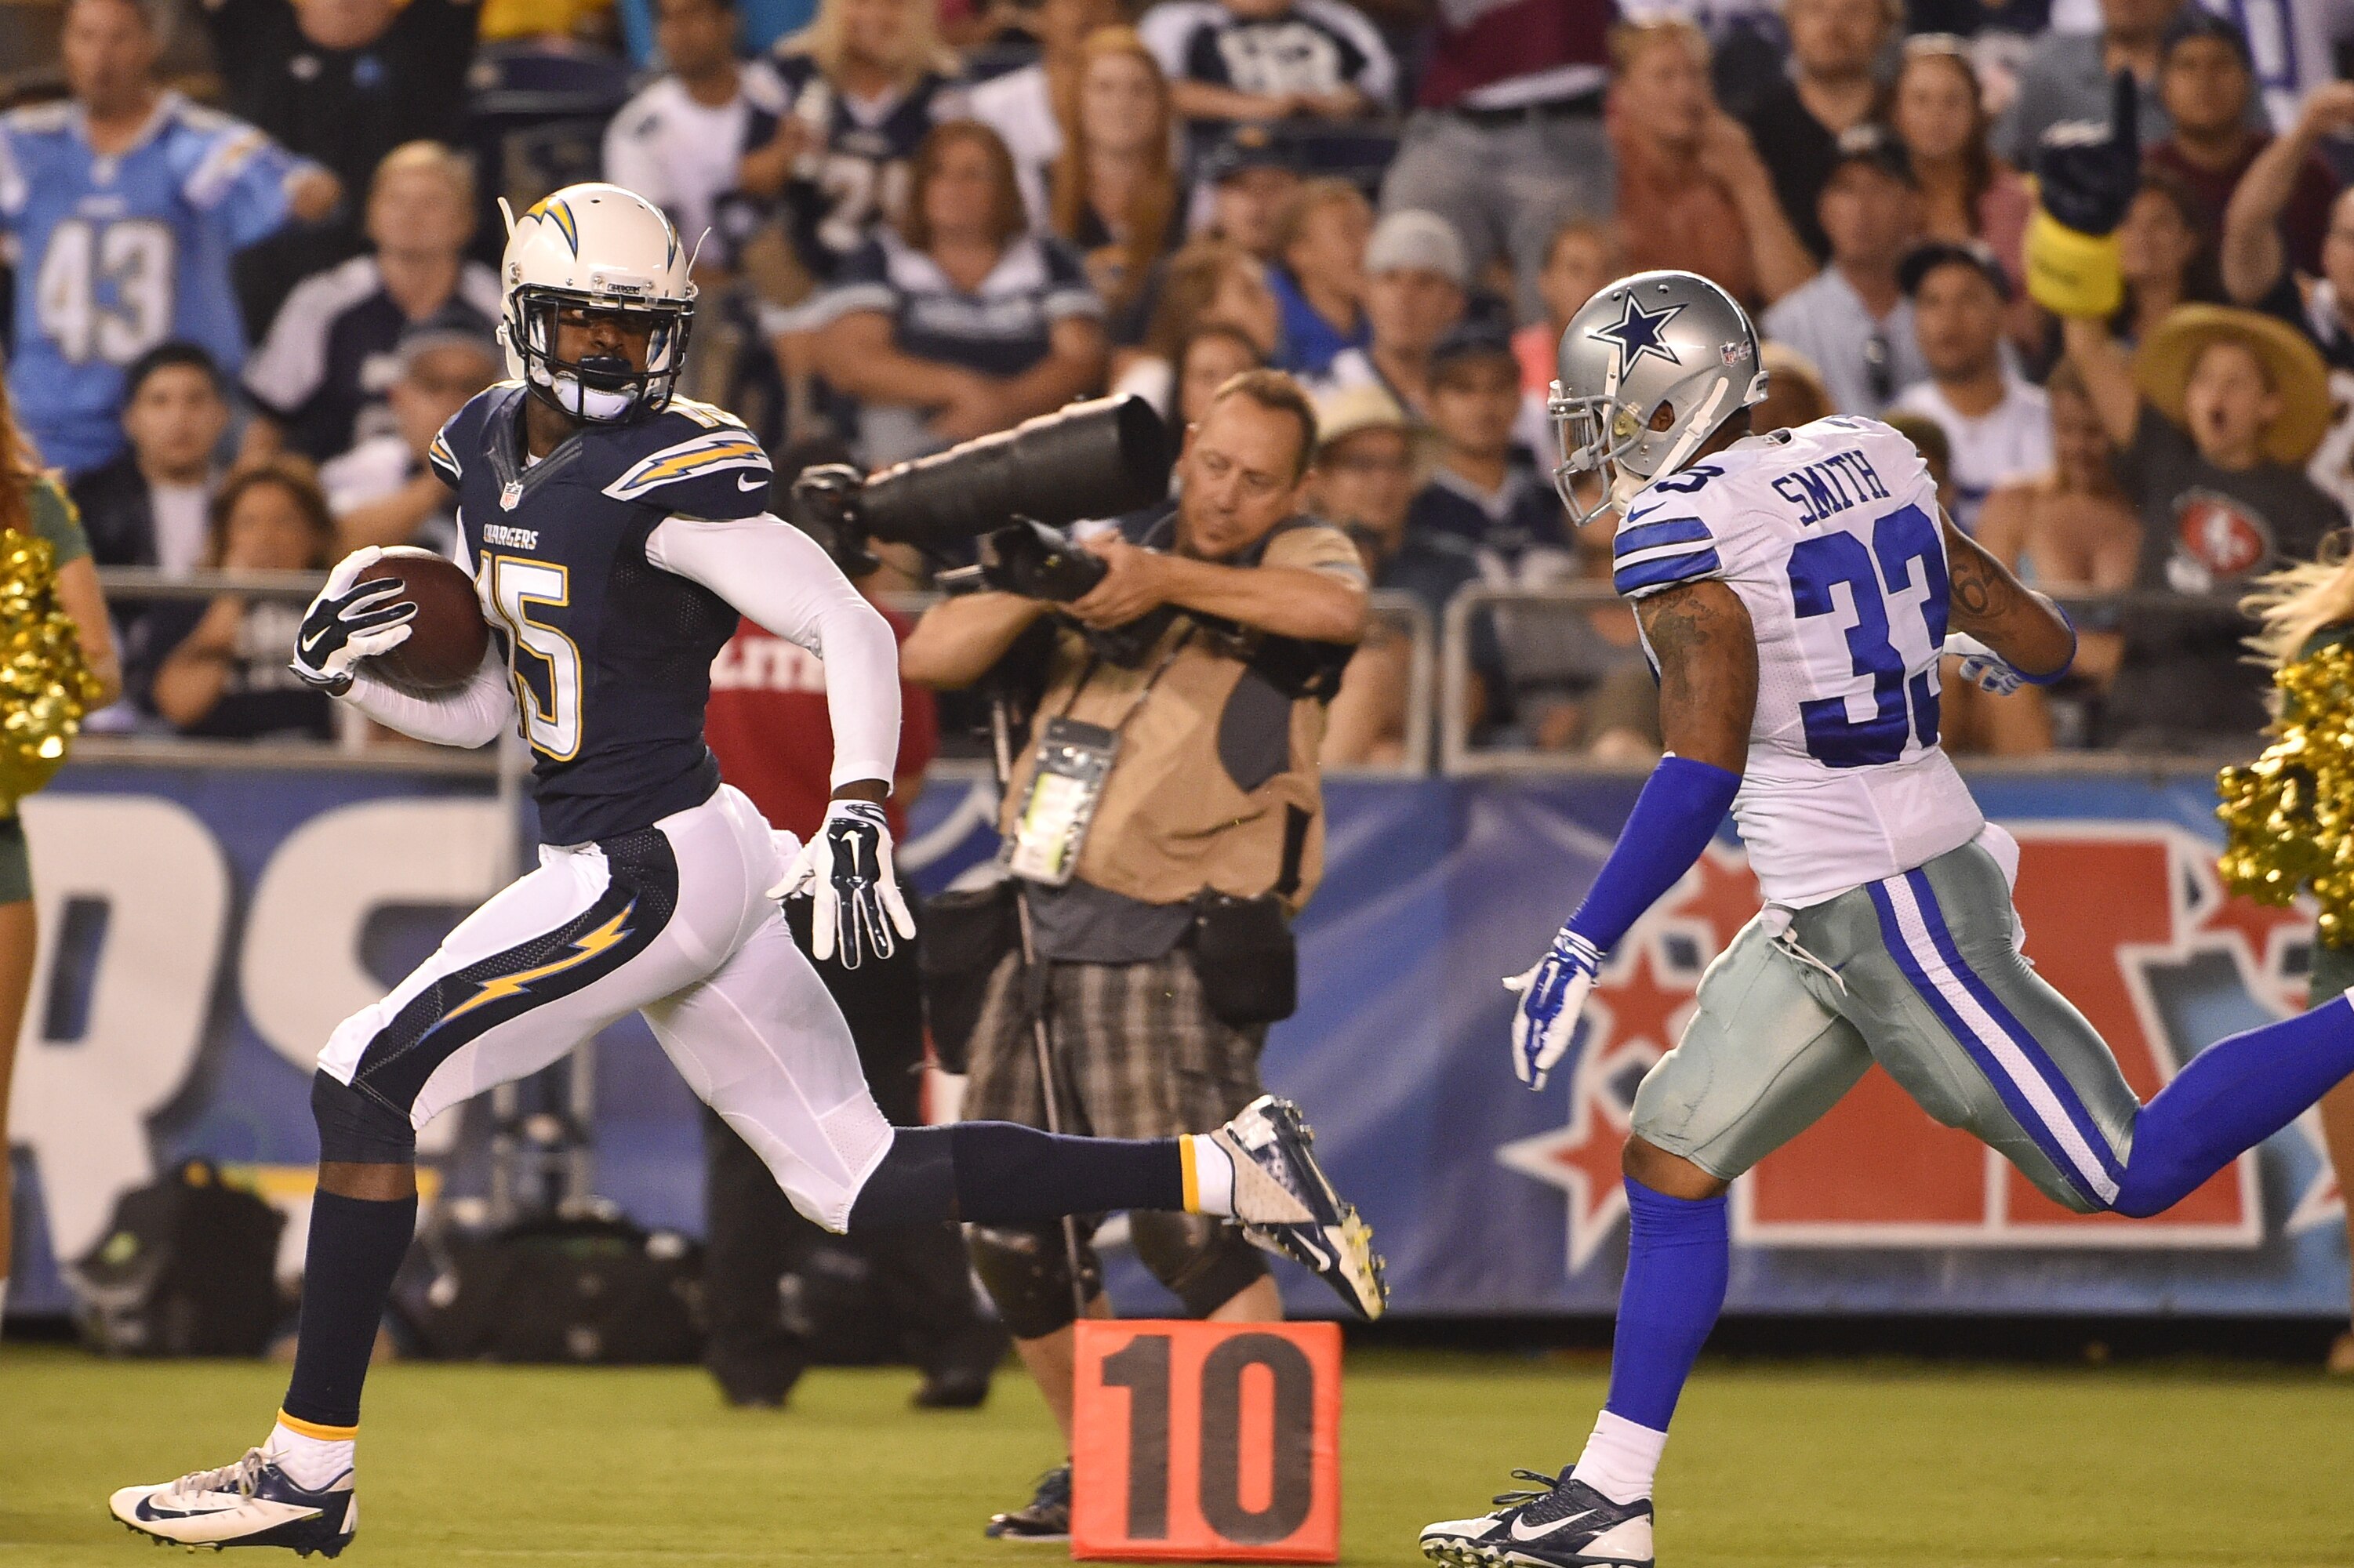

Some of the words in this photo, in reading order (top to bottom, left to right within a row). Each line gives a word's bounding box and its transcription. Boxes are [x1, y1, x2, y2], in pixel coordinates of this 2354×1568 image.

[38, 217, 176, 364] 43
[1771, 449, 1891, 527] SMITH
[474, 550, 583, 762] 15
[1786, 503, 1950, 768] 33
[1101, 1332, 1313, 1545] 10
